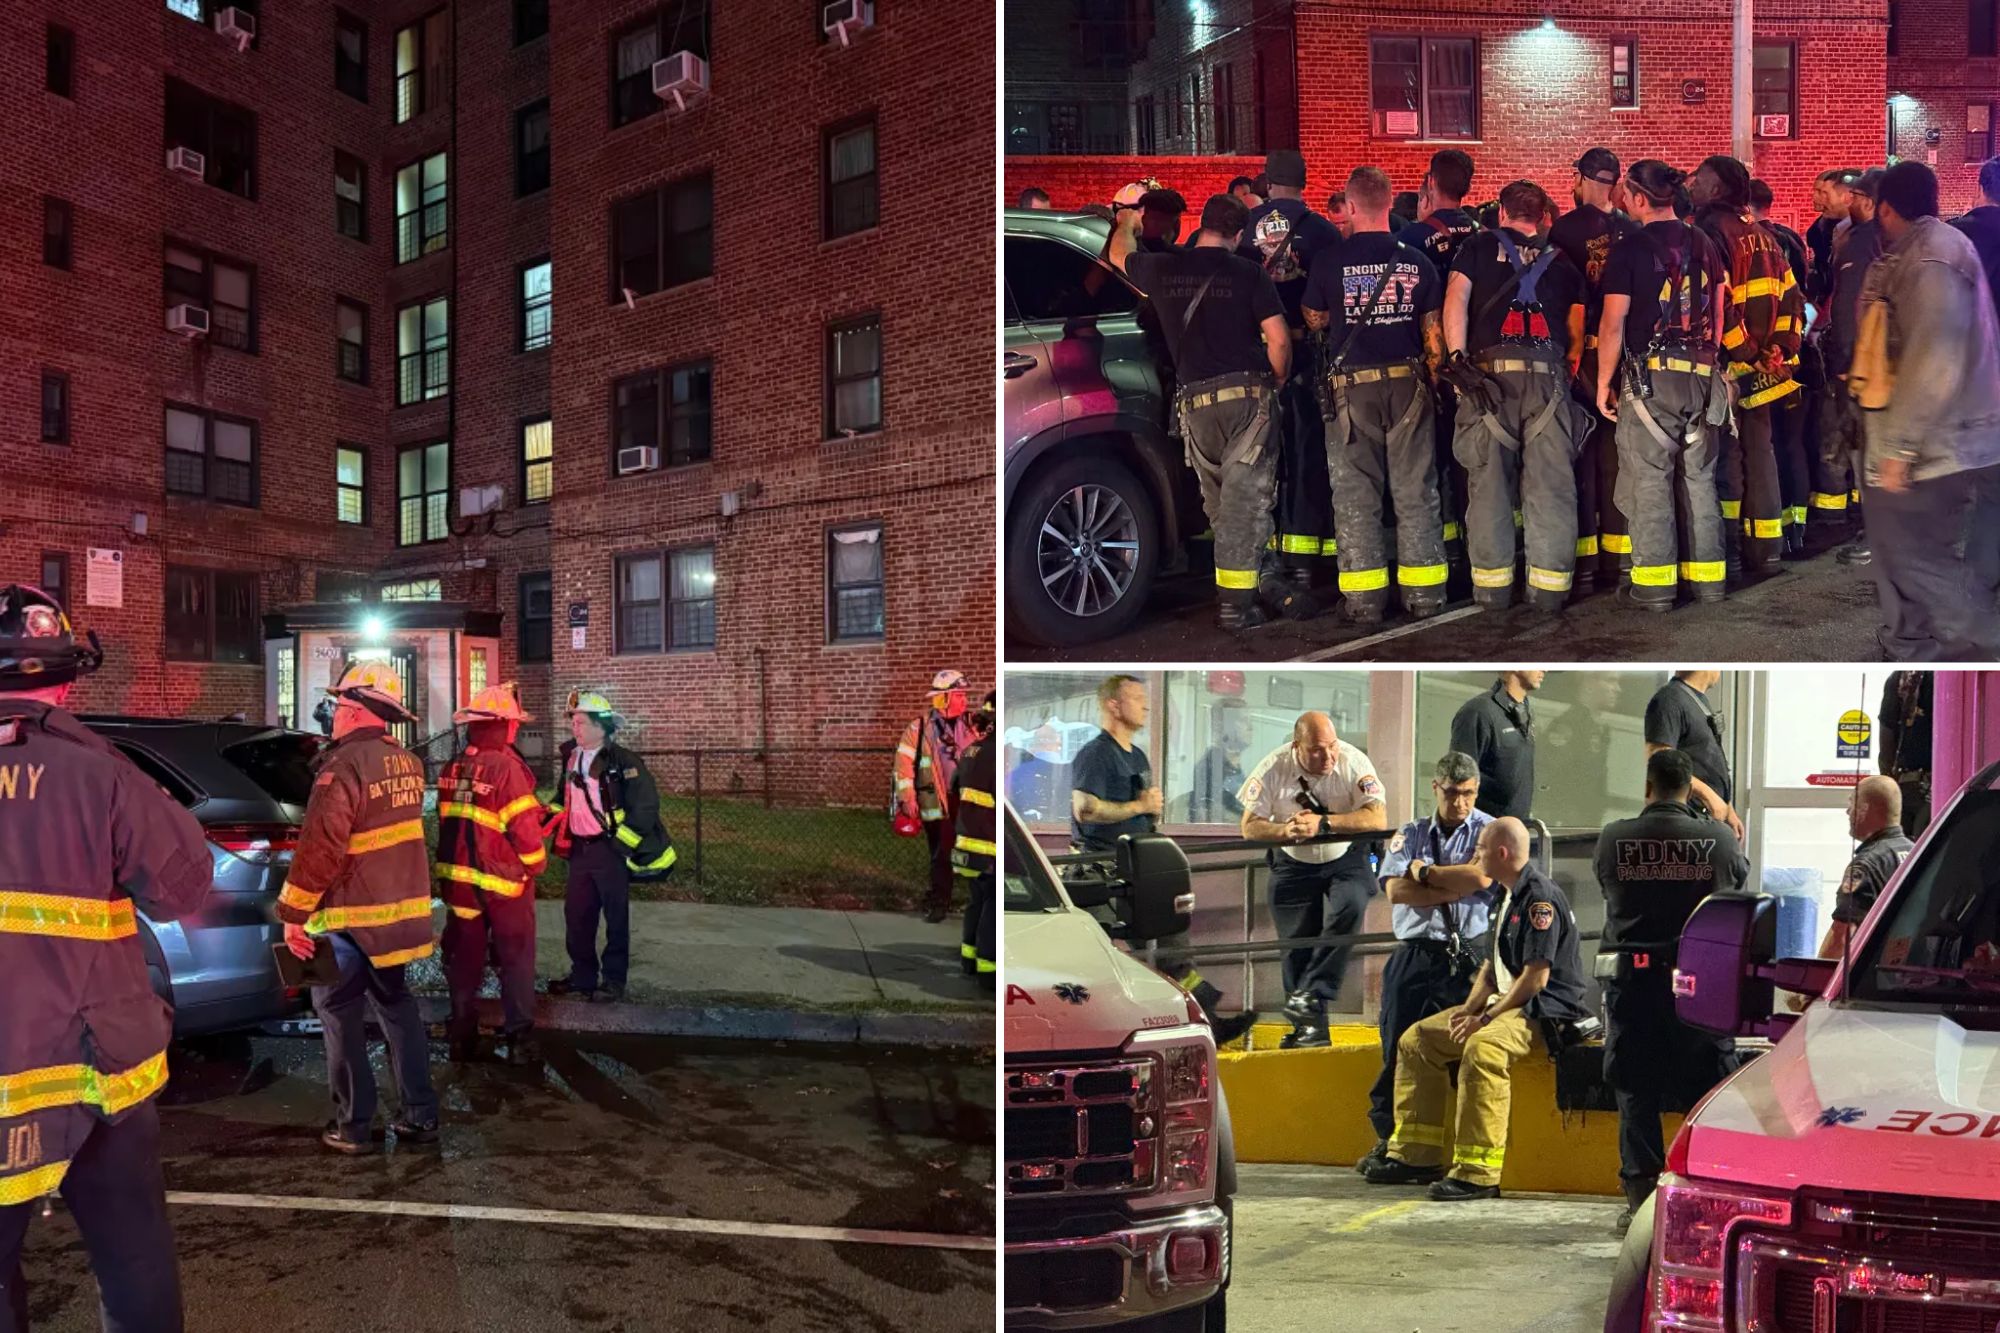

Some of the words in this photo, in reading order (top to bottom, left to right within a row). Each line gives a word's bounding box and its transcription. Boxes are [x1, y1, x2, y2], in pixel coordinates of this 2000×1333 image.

[1395, 263, 1418, 274] 290
[1345, 304, 1394, 316] LADER
[1616, 839, 1716, 865] FDNY
[1617, 865, 1713, 881] PARAMEDIC
